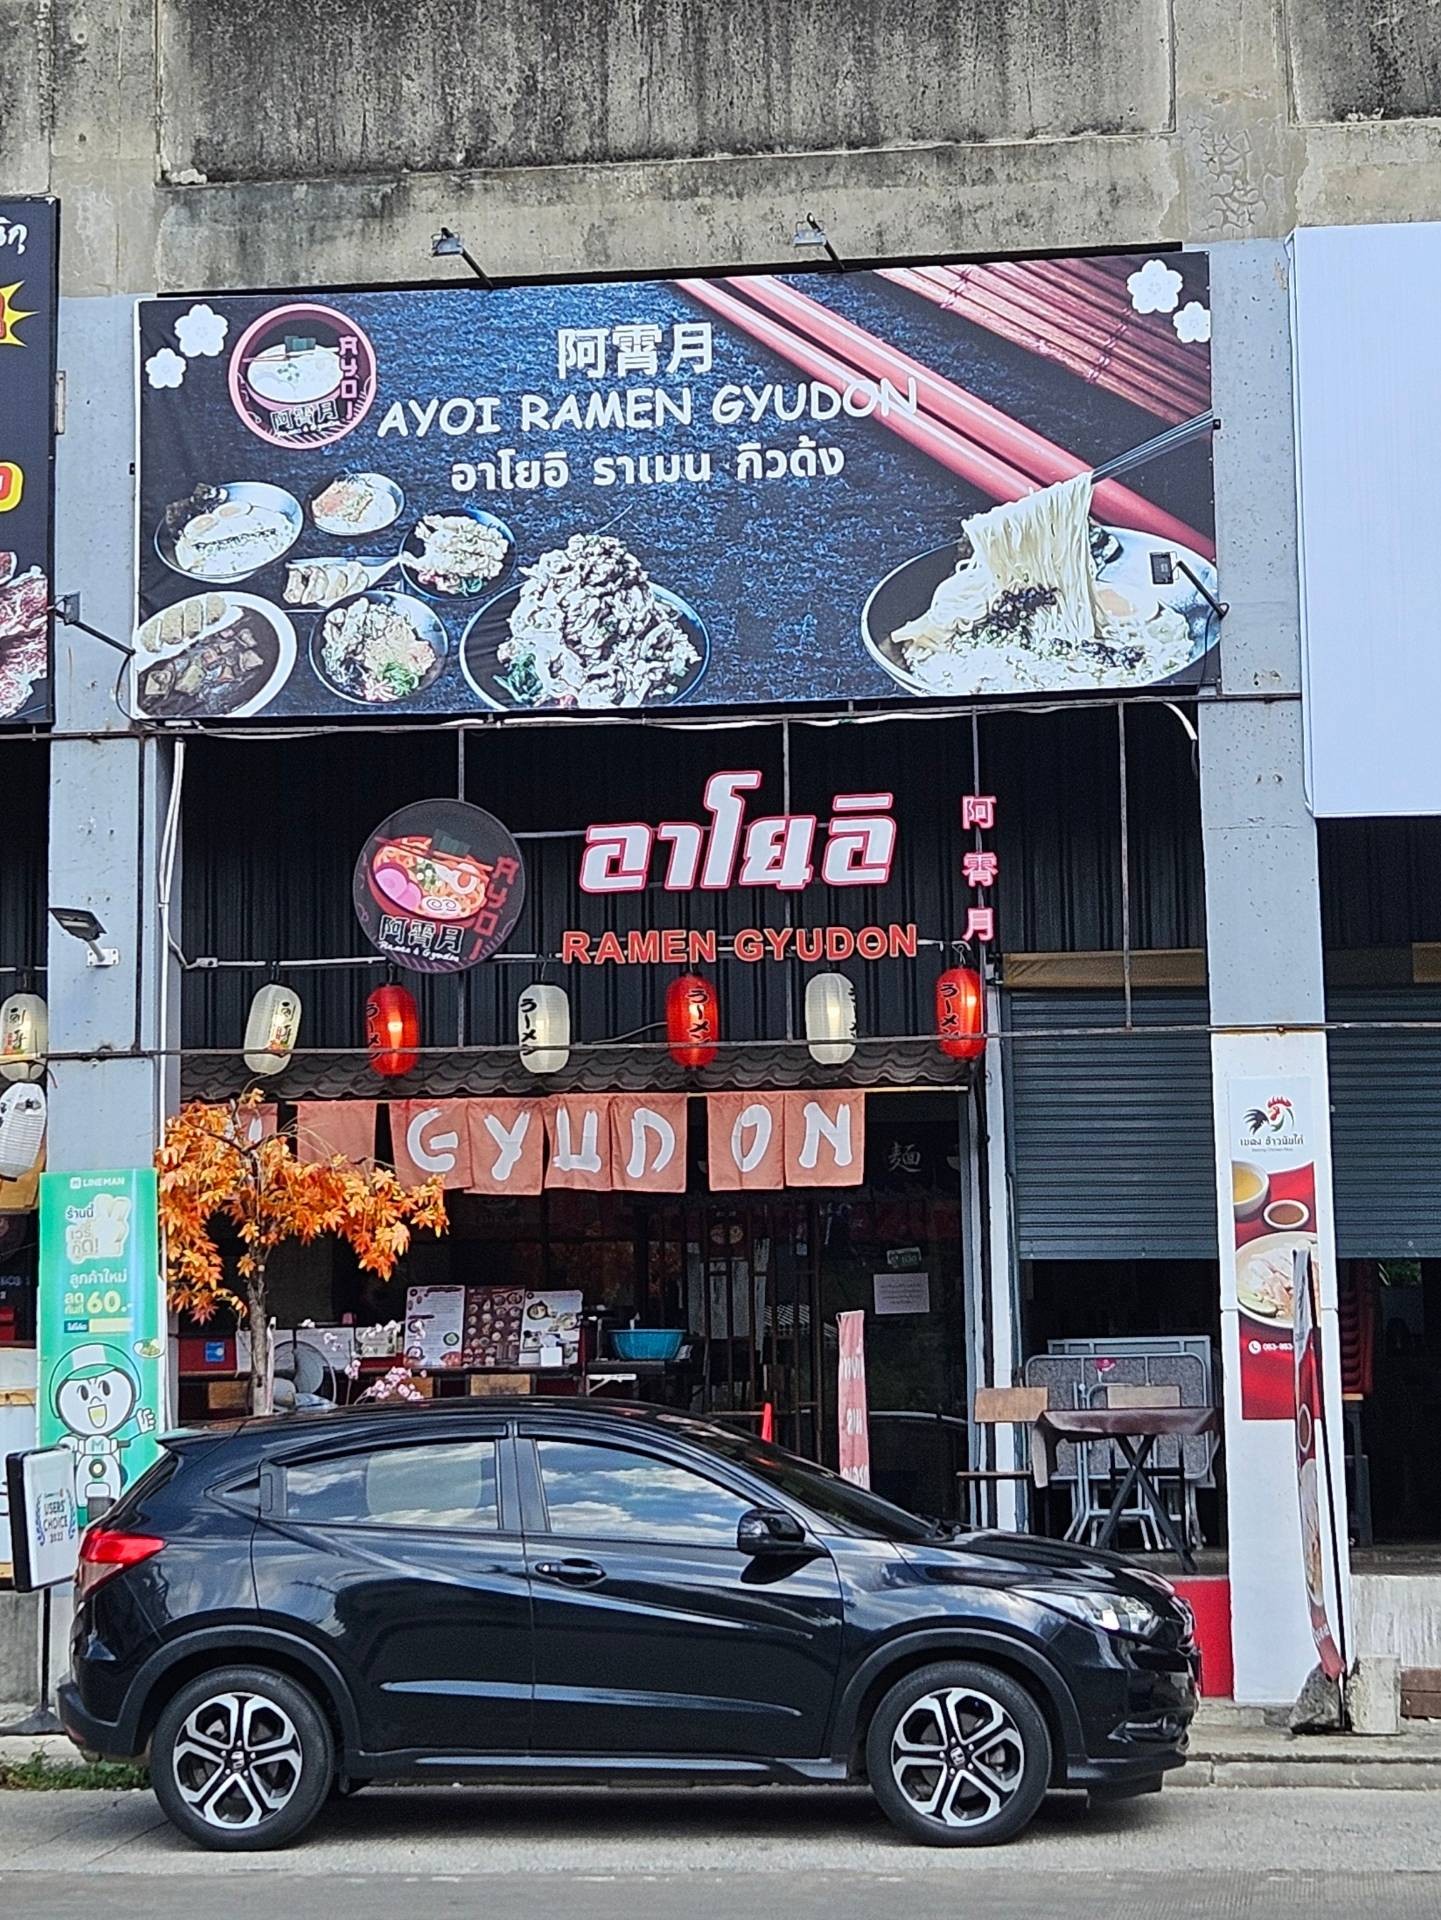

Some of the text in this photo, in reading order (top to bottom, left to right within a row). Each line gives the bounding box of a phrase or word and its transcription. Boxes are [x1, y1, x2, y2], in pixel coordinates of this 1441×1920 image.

[338, 335, 359, 420] AYOI
[557, 321, 713, 380] 阿霄月
[377, 377, 918, 438] AYOI RAMEN GYUDON
[451, 449, 569, 492] อาโยอิ
[593, 453, 711, 487] ราเมน
[579, 769, 897, 893] อาโยอิ
[378, 914, 465, 954] 阿霄月
[562, 923, 918, 965] RAMEN GYUDON
[406, 1101, 853, 1182] GYUDON
[43, 1515, 68, 1531] CHOICE
